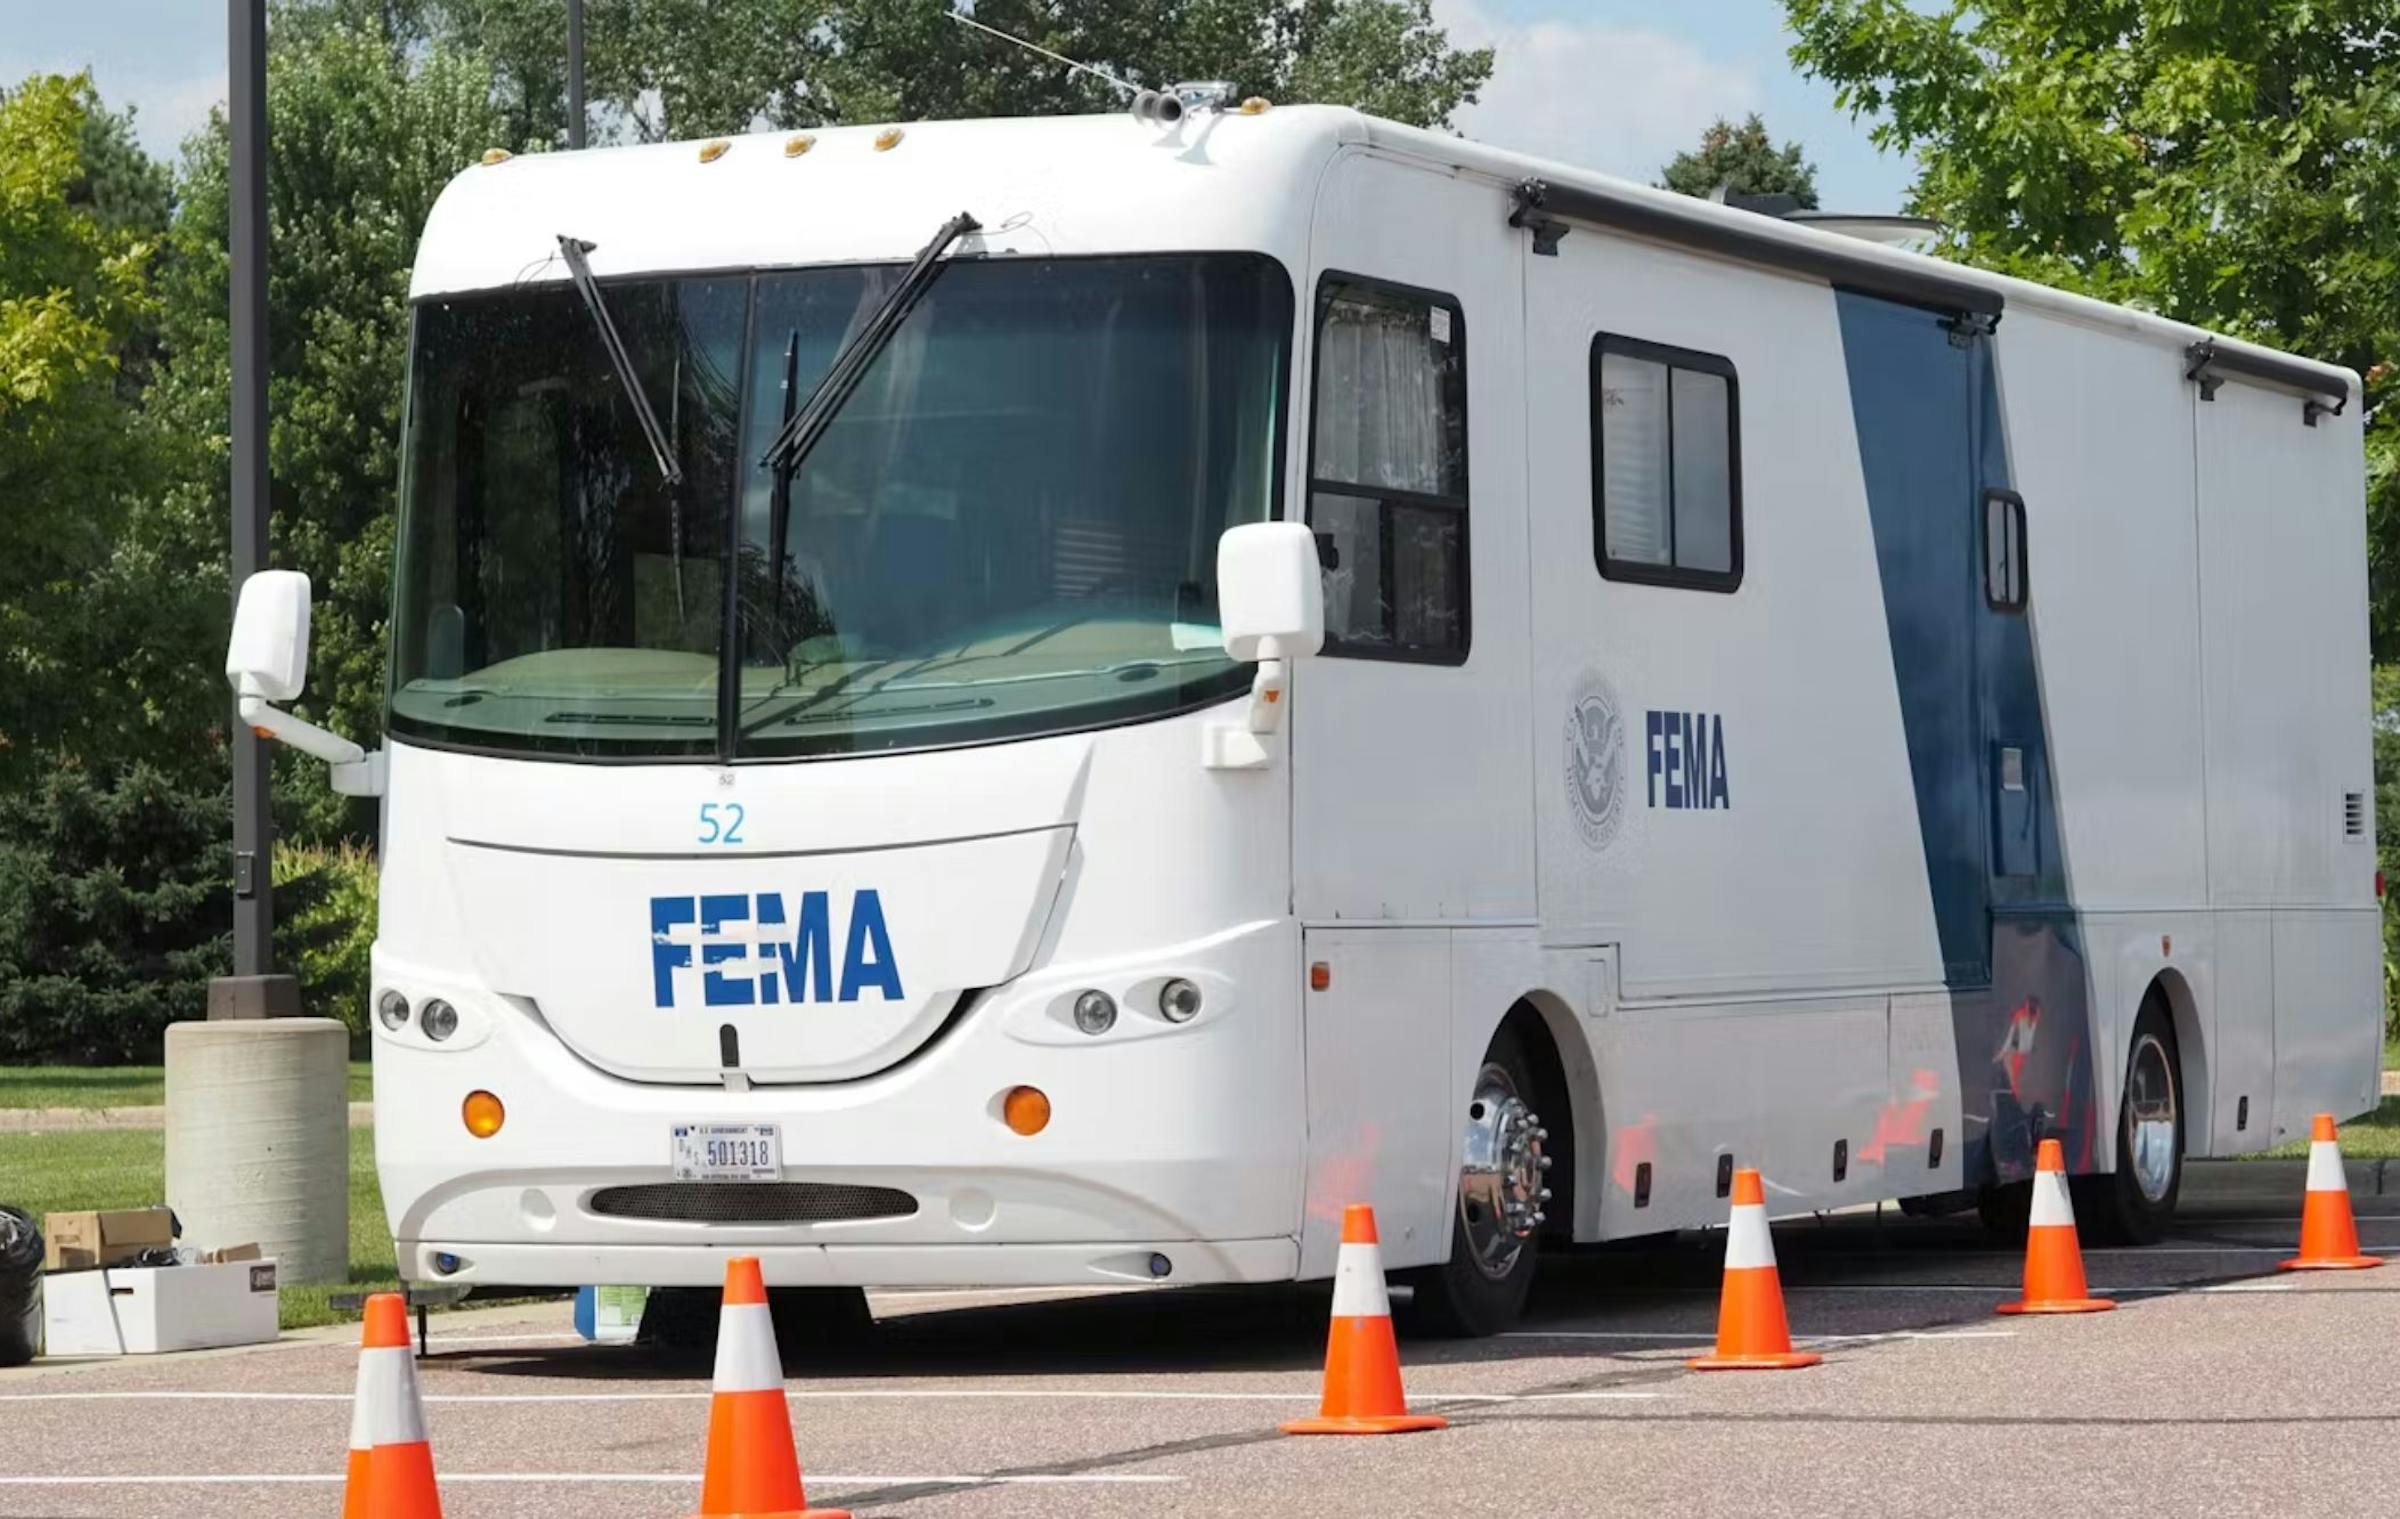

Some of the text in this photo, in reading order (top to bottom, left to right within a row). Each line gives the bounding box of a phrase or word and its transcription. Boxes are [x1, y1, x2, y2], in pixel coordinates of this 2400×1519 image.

[719, 774, 735, 786] 52
[1646, 710, 1730, 810] FEMA
[699, 803, 744, 843] 52
[650, 888, 905, 1008] FEMA
[708, 1140, 769, 1166] 501318
